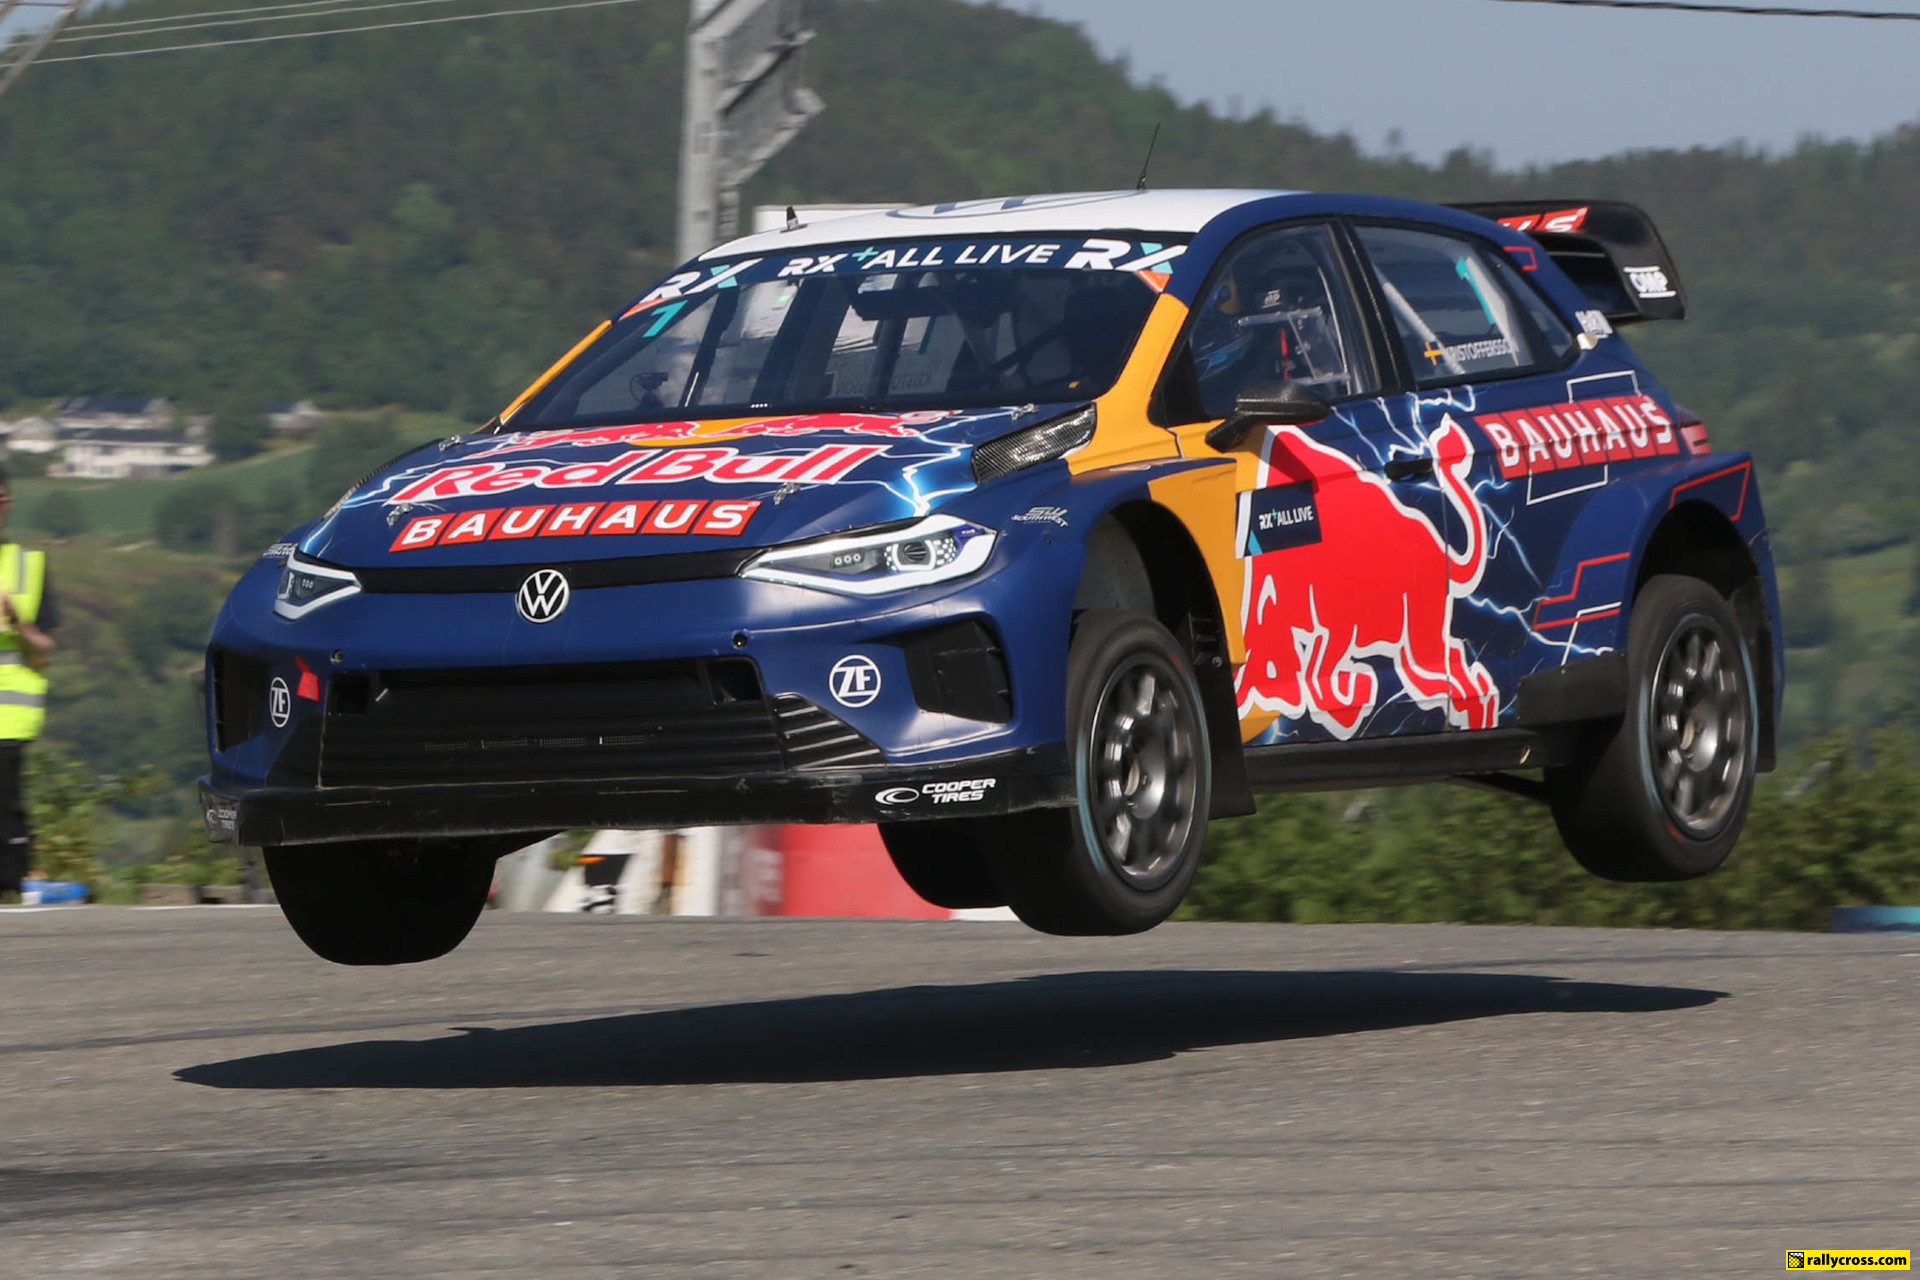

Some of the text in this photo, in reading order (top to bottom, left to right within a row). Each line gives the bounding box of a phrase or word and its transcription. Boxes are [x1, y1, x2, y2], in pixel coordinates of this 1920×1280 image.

[954, 244, 1060, 264] LIVE
[1063, 238, 1188, 274] RX
[639, 257, 763, 304] RX
[643, 300, 688, 337] 1
[1485, 402, 1673, 467] BAUHAUS
[385, 445, 893, 506] Red Bull
[401, 501, 751, 546] BAUHAUS
[1293, 505, 1314, 523] LIVE
[921, 778, 996, 794] COOPER
[932, 790, 984, 804] TIRES
